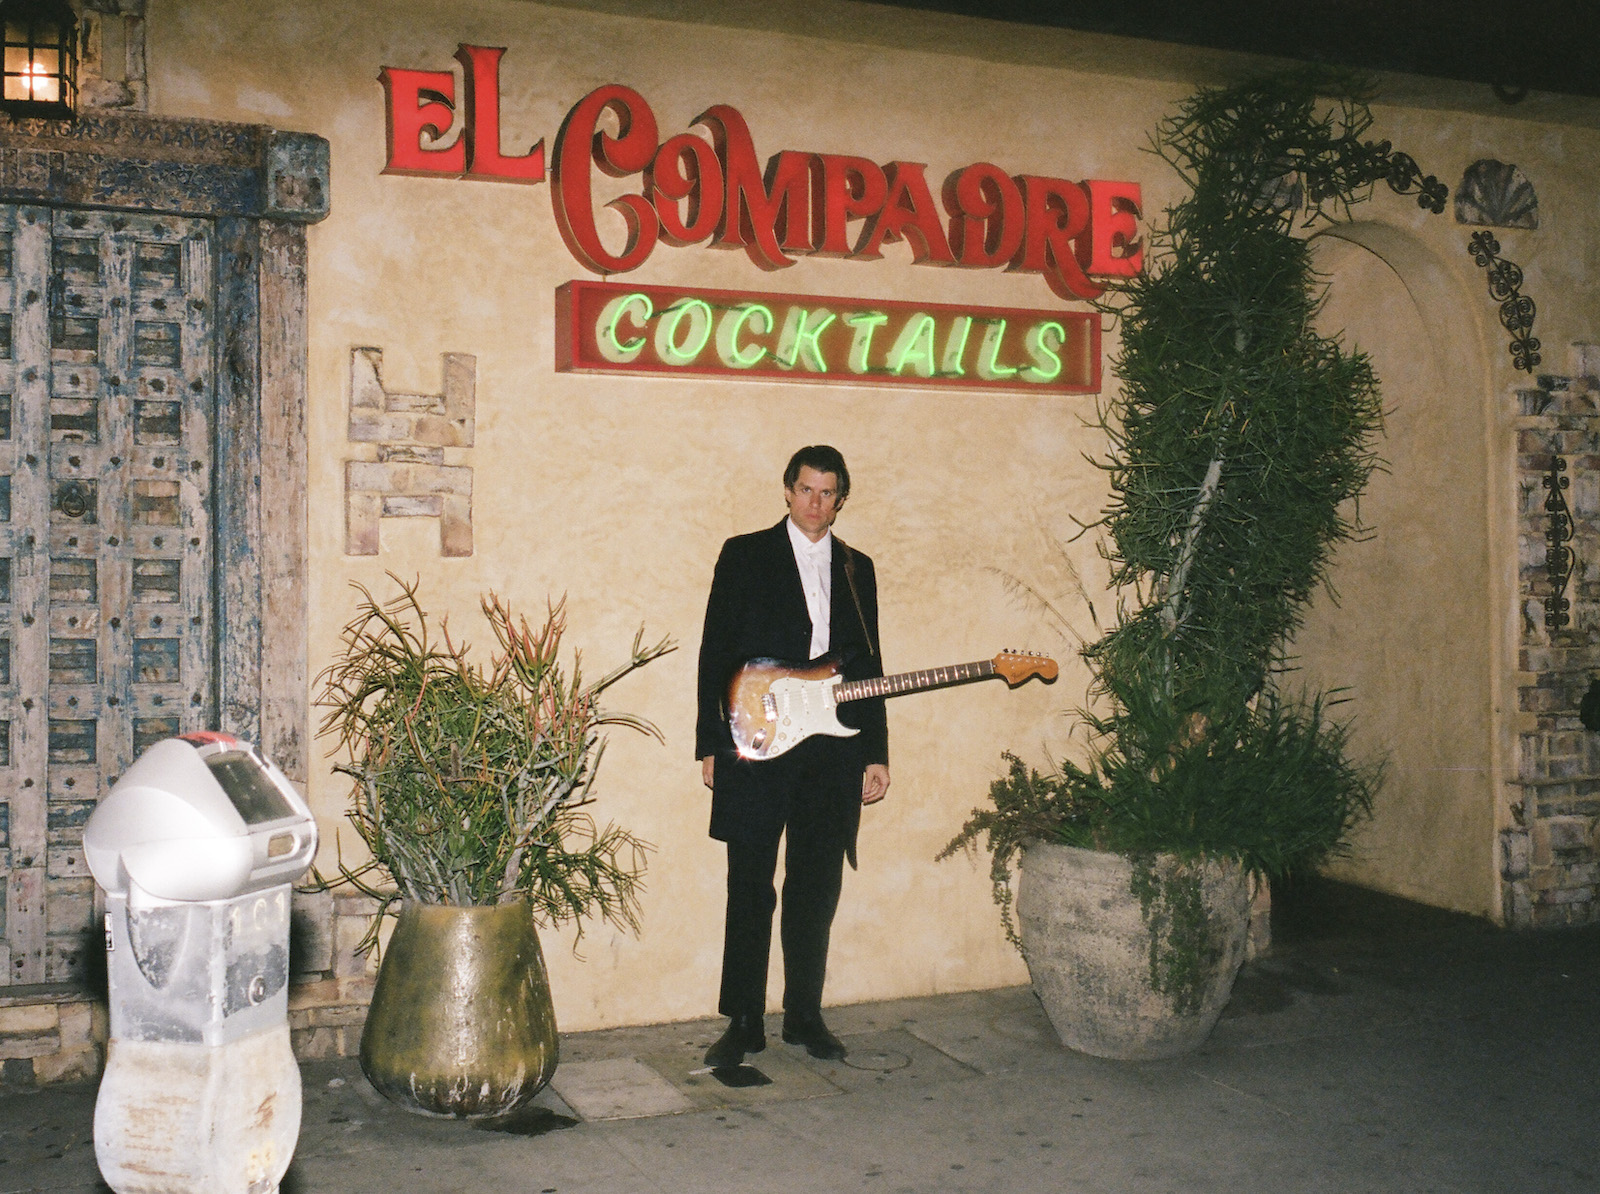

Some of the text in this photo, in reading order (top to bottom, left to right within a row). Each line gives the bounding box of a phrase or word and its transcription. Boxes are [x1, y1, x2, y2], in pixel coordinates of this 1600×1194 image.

[378, 43, 1144, 299] EL COMPADRE
[596, 292, 1066, 382] COCKTAILS
